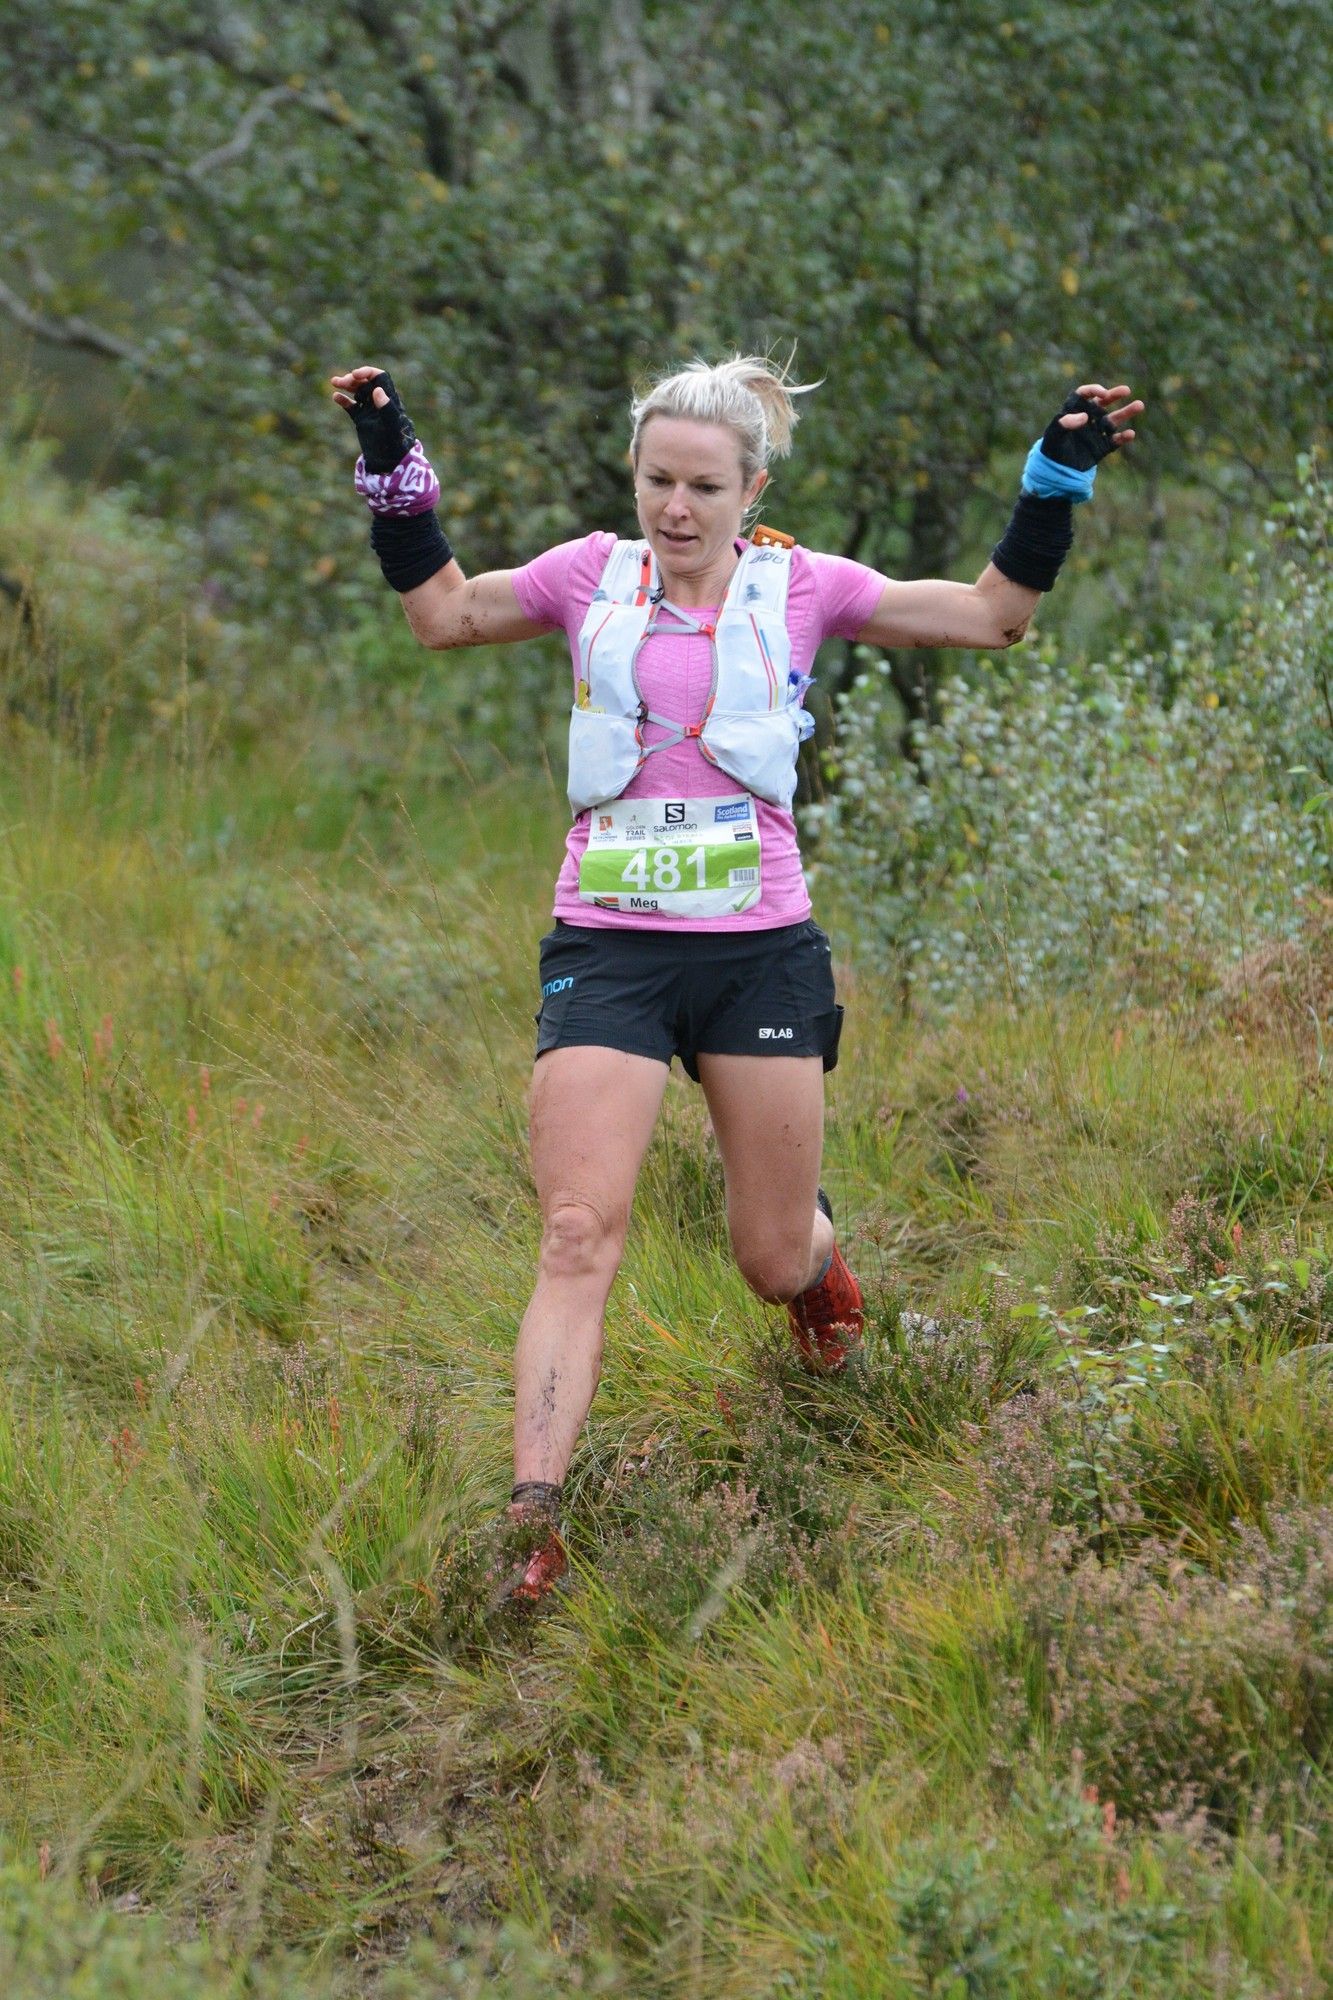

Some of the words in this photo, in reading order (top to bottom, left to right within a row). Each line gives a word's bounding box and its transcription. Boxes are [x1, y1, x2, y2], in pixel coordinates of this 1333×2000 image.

[717, 803, 748, 816] Scotland
[621, 847, 706, 891] 481
[630, 898, 658, 911] Meg
